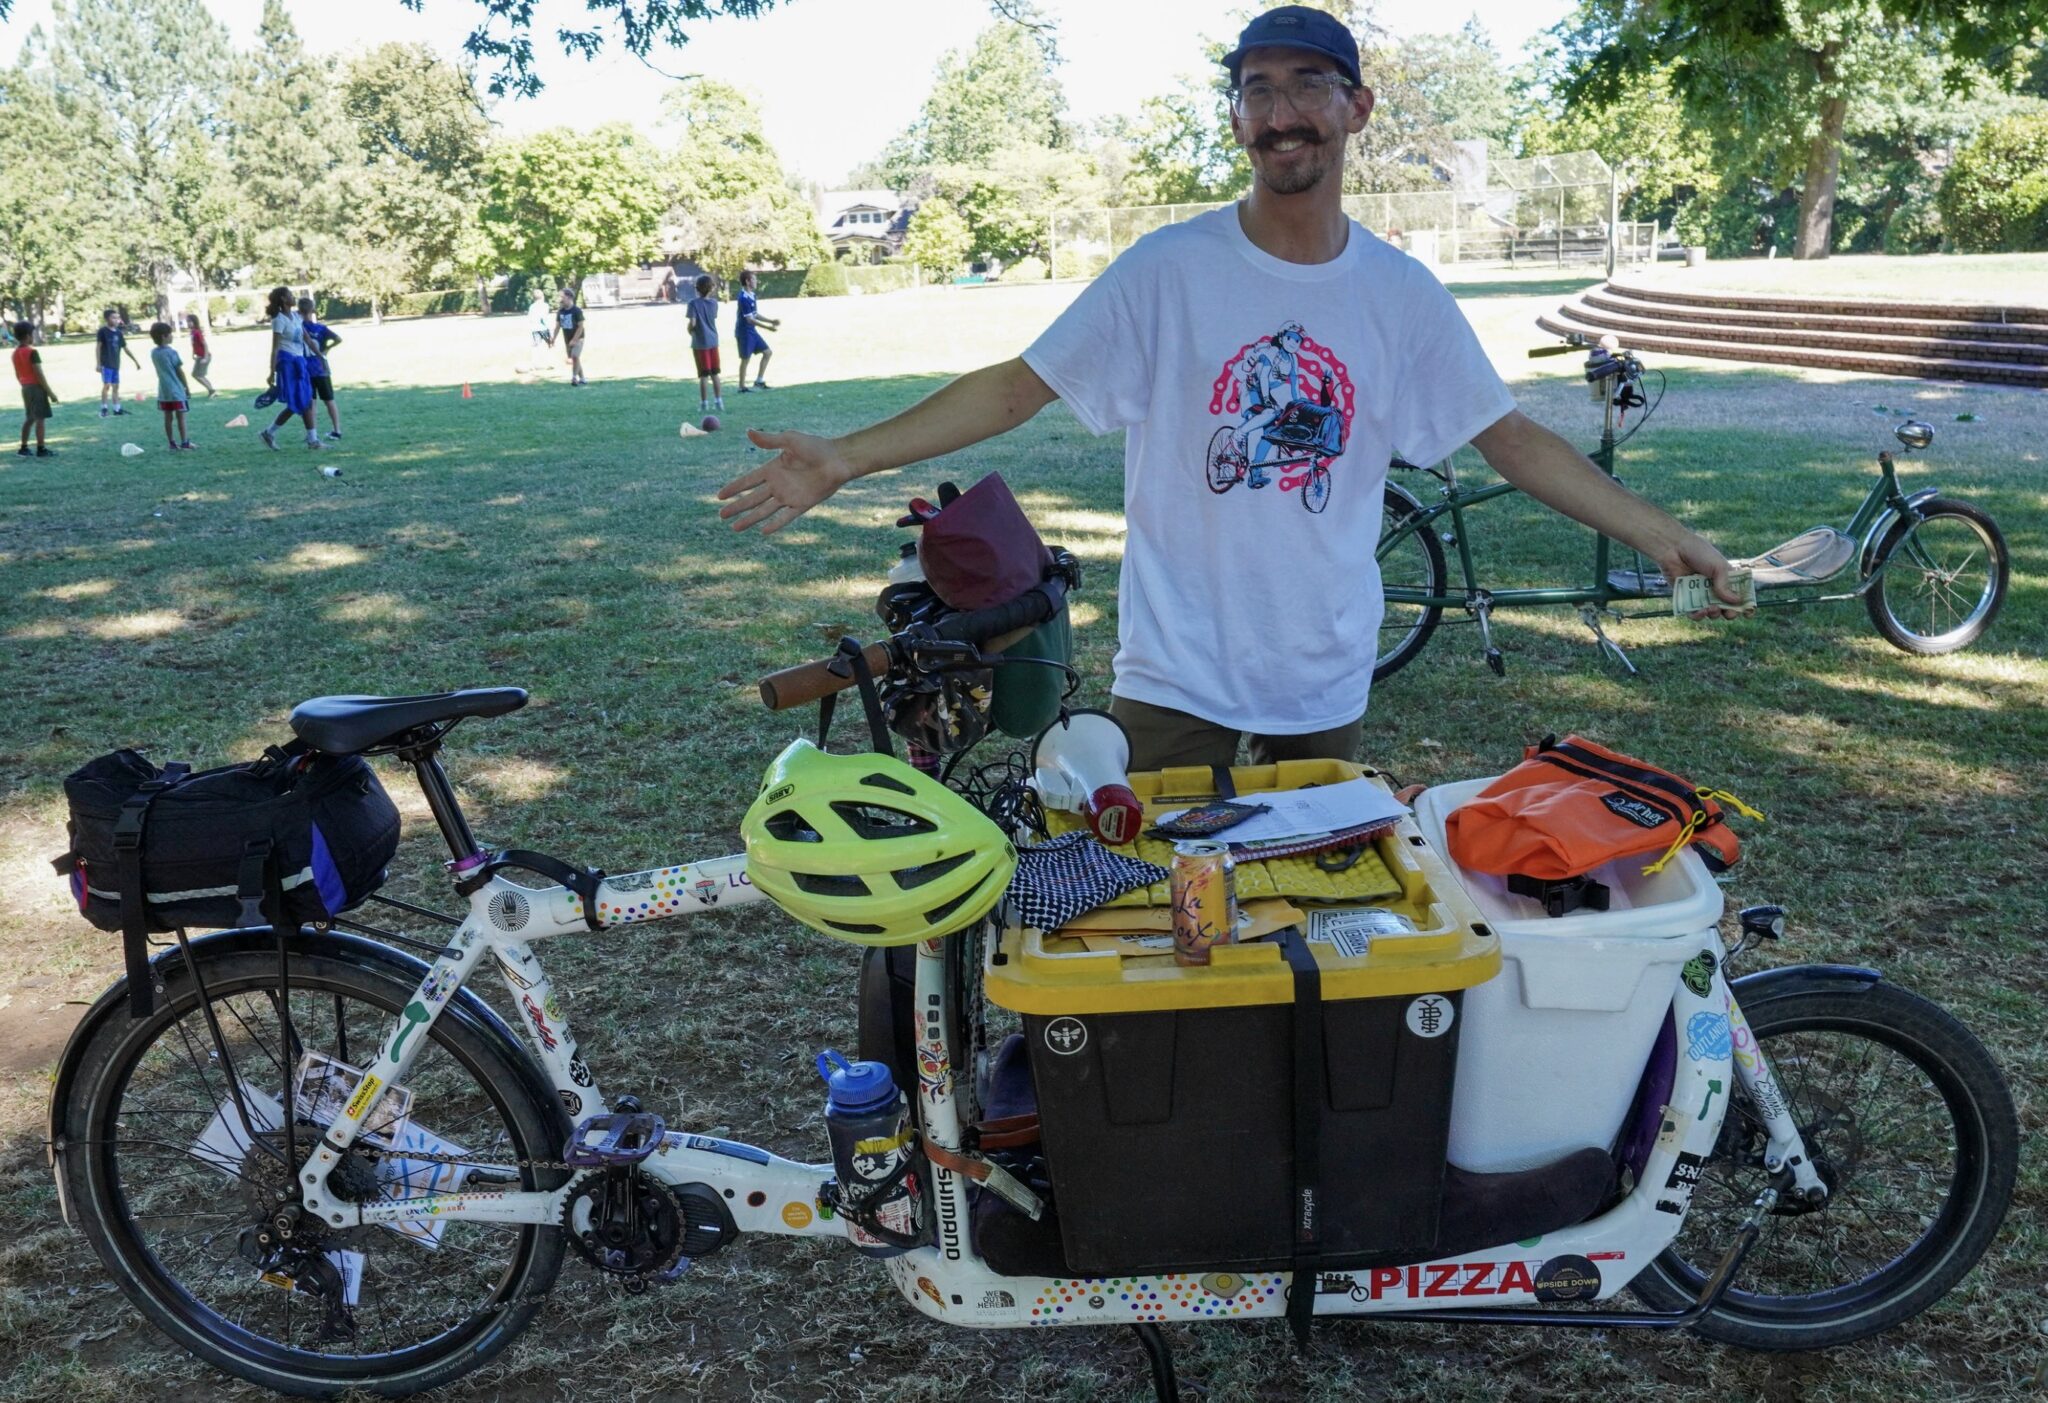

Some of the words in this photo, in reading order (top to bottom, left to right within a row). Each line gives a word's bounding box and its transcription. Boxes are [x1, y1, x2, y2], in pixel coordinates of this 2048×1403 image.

[768, 786, 790, 802] ABUS
[352, 1077, 375, 1109] SwissStop
[937, 1167, 960, 1261] SHIMANO
[1301, 1188, 1315, 1230] xtracycle
[1370, 1261, 1535, 1300] PIZZA
[1536, 1279, 1568, 1289] UPSIDE
